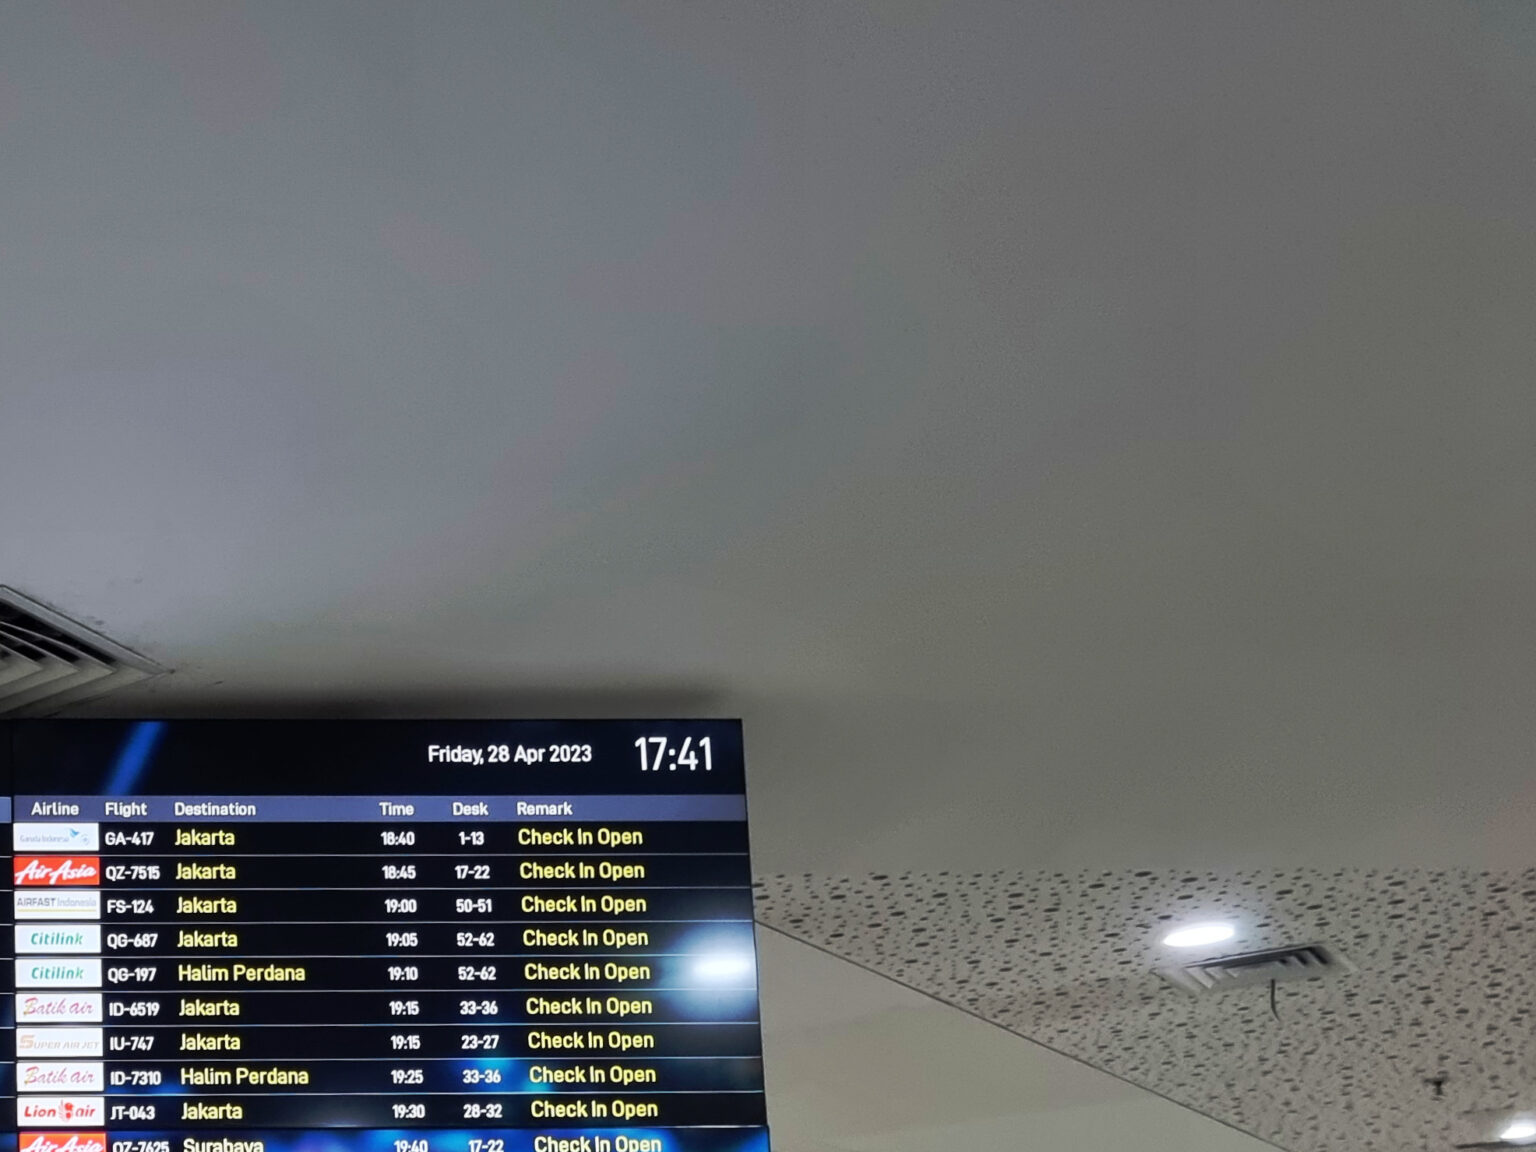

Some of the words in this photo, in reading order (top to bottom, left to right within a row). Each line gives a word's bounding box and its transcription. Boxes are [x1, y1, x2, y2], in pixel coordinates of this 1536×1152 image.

[428, 744, 484, 767] Friday,
[488, 744, 510, 763] 28
[514, 744, 546, 767] Apr
[549, 744, 593, 763] 2023
[634, 736, 713, 771] 17:41
[31, 801, 78, 815] Airline
[105, 802, 147, 817] Flight
[174, 801, 255, 815] Destination
[378, 801, 414, 815] Time
[452, 801, 488, 815] Desk
[516, 801, 572, 815] Remark
[106, 866, 160, 881] QZ-7515
[176, 863, 235, 879] Jakarta
[382, 866, 416, 879] 18:45
[455, 865, 490, 879] 17-22
[520, 862, 575, 878] Check
[579, 862, 594, 878] In
[599, 862, 644, 881] Open
[17, 897, 56, 907] AIRFAST
[107, 900, 154, 913] FS-124
[177, 897, 236, 913] Jakarta
[385, 899, 417, 912] 19:00
[456, 899, 492, 912] 50-51
[522, 896, 577, 912] Check
[581, 896, 596, 912] In
[601, 896, 646, 914] Open
[24, 1065, 67, 1084] Batik
[70, 1070, 96, 1084] air
[111, 1071, 161, 1085] ID-7310
[181, 1068, 231, 1084] Halim
[236, 1068, 308, 1084] Perdana
[391, 1070, 423, 1083] 19:25
[463, 1070, 501, 1083] 33-36
[530, 1066, 586, 1083] Check
[590, 1066, 605, 1082] In
[610, 1066, 656, 1085] Open
